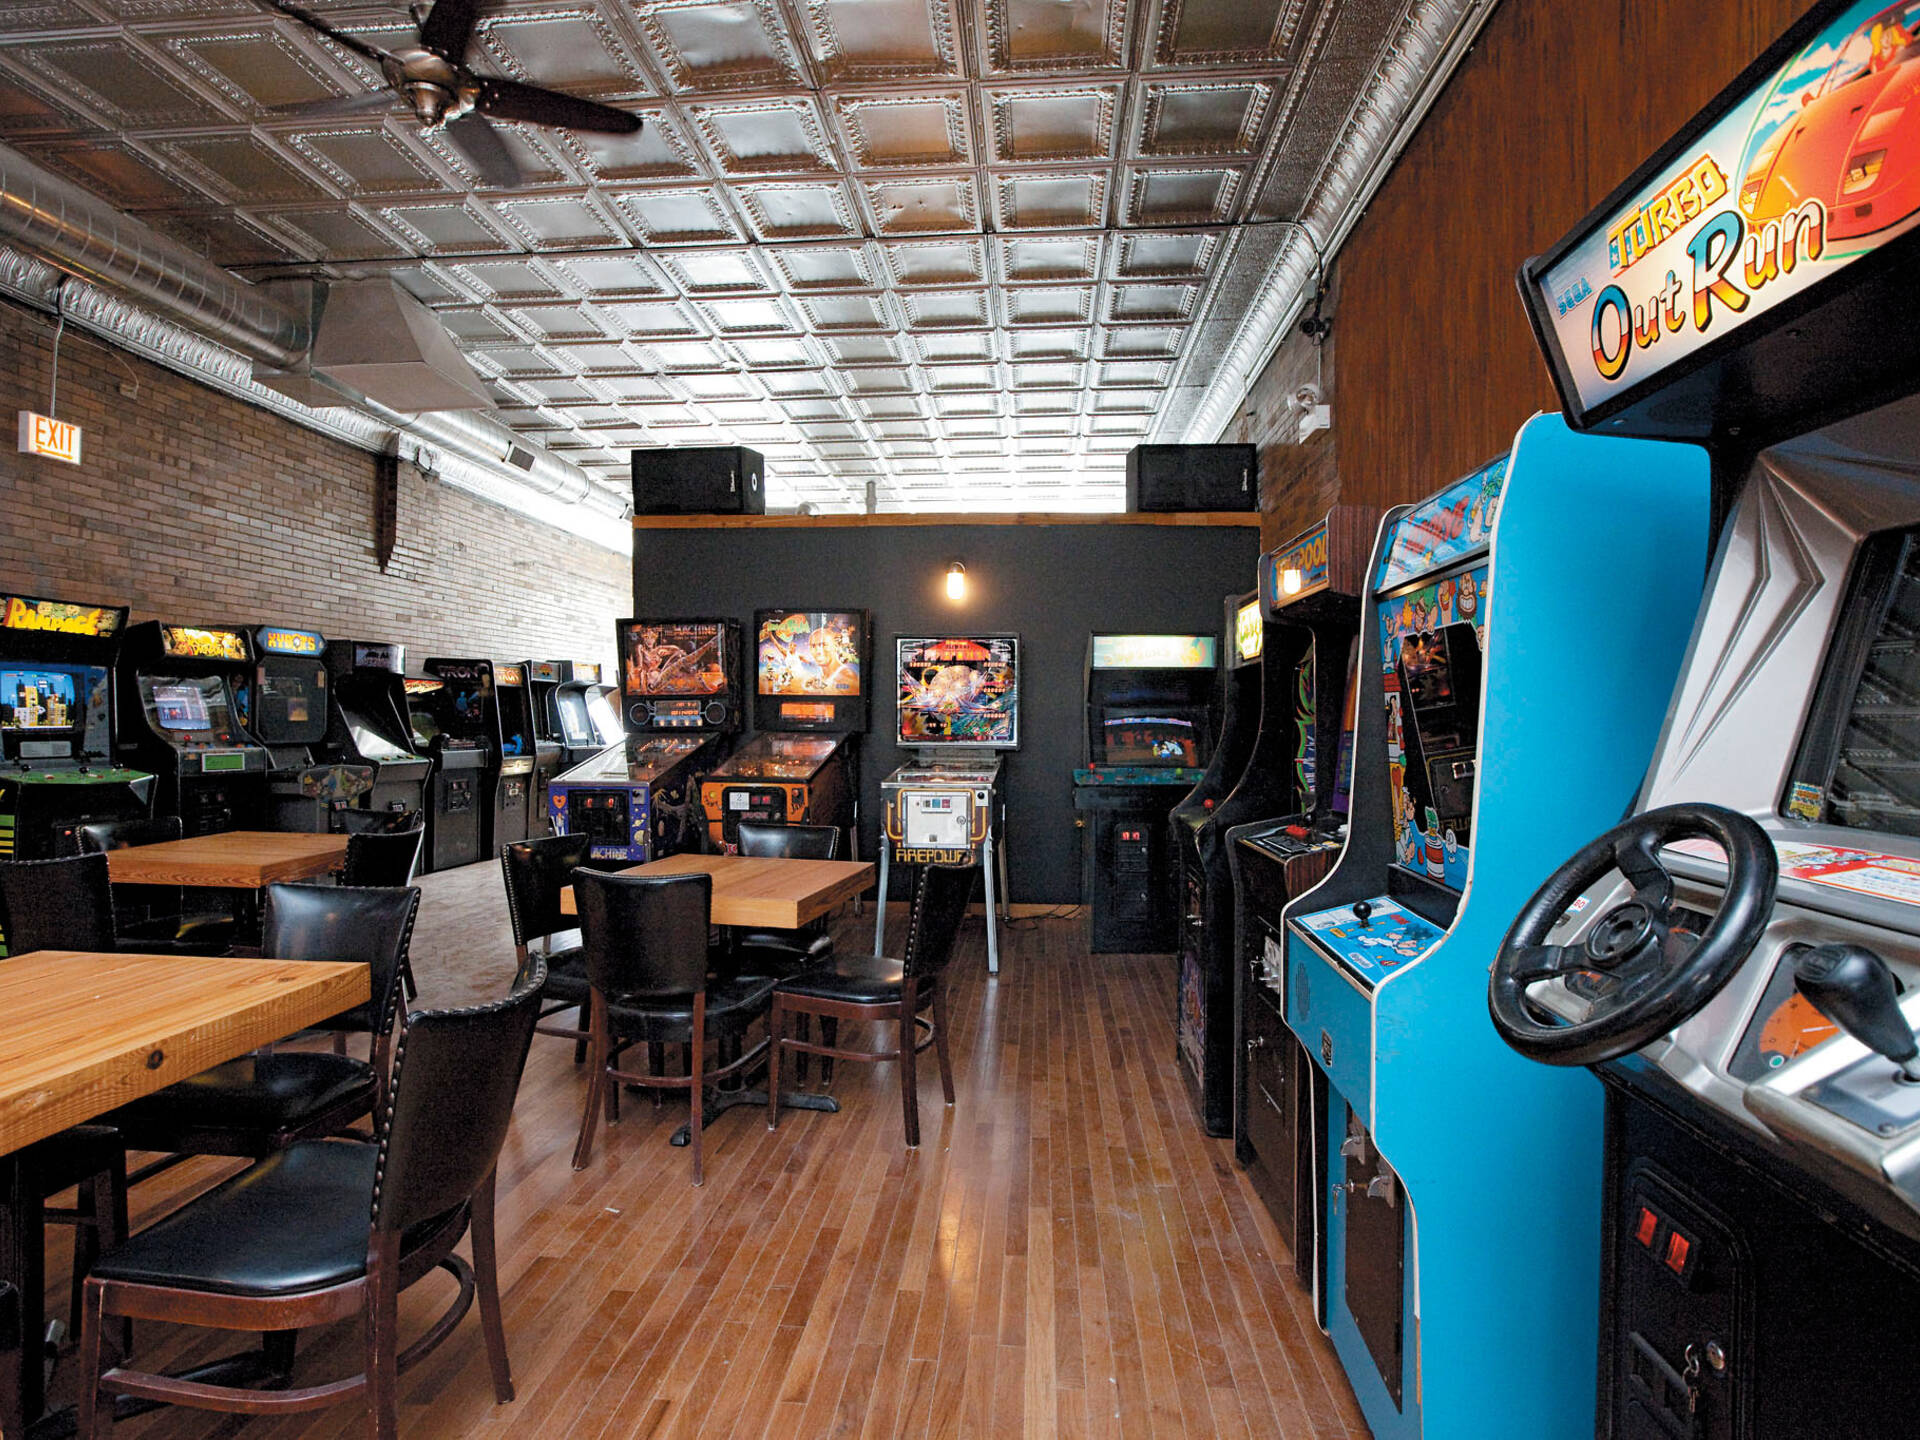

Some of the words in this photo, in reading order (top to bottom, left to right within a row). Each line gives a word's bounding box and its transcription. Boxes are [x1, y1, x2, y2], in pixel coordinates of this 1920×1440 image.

[1608, 157, 1728, 268] TURBO
[1557, 276, 1594, 318] SEGA
[36, 416, 75, 452] EXIT
[437, 665, 479, 678] TRON
[591, 847, 628, 860] ACHINE
[896, 848, 974, 863] FIREPOWE
